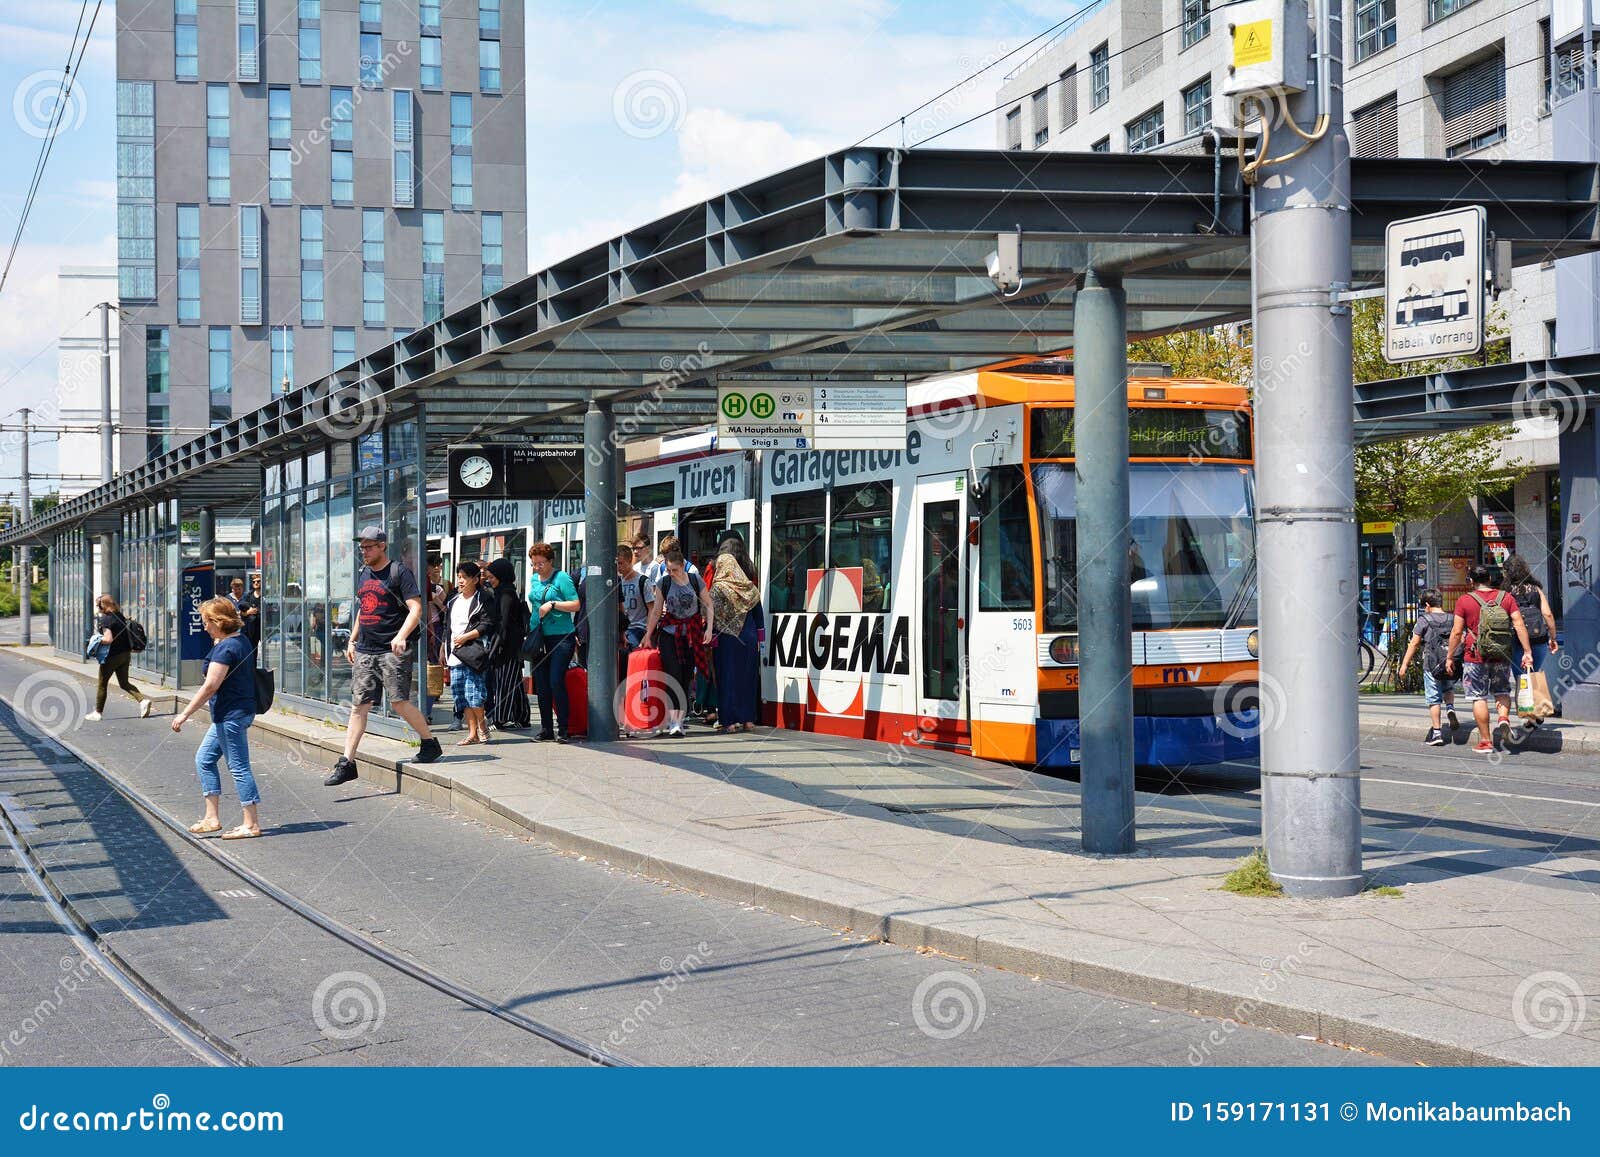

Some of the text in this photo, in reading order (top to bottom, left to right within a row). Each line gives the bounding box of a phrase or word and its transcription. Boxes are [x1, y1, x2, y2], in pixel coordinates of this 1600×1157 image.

[1391, 331, 1473, 350] haben Vorrang
[820, 389, 827, 398] 3
[821, 401, 827, 410] 4
[783, 412, 804, 421] rnv
[744, 426, 802, 434] Hauptbahnhof
[1128, 426, 1208, 442] aldfriedhof
[751, 439, 771, 447] Steig
[527, 449, 577, 459] Hauptbahnhof
[678, 461, 735, 500] Türen
[467, 499, 519, 529] Rollladen
[544, 499, 585, 519] Fenst
[425, 511, 447, 534] üren
[189, 586, 202, 636] Tickets
[1013, 618, 1033, 631] 5603
[768, 612, 910, 676] KAGEMA
[1065, 673, 1079, 686] 56
[1162, 666, 1202, 683] rnv
[1001, 688, 1017, 697] rnv
